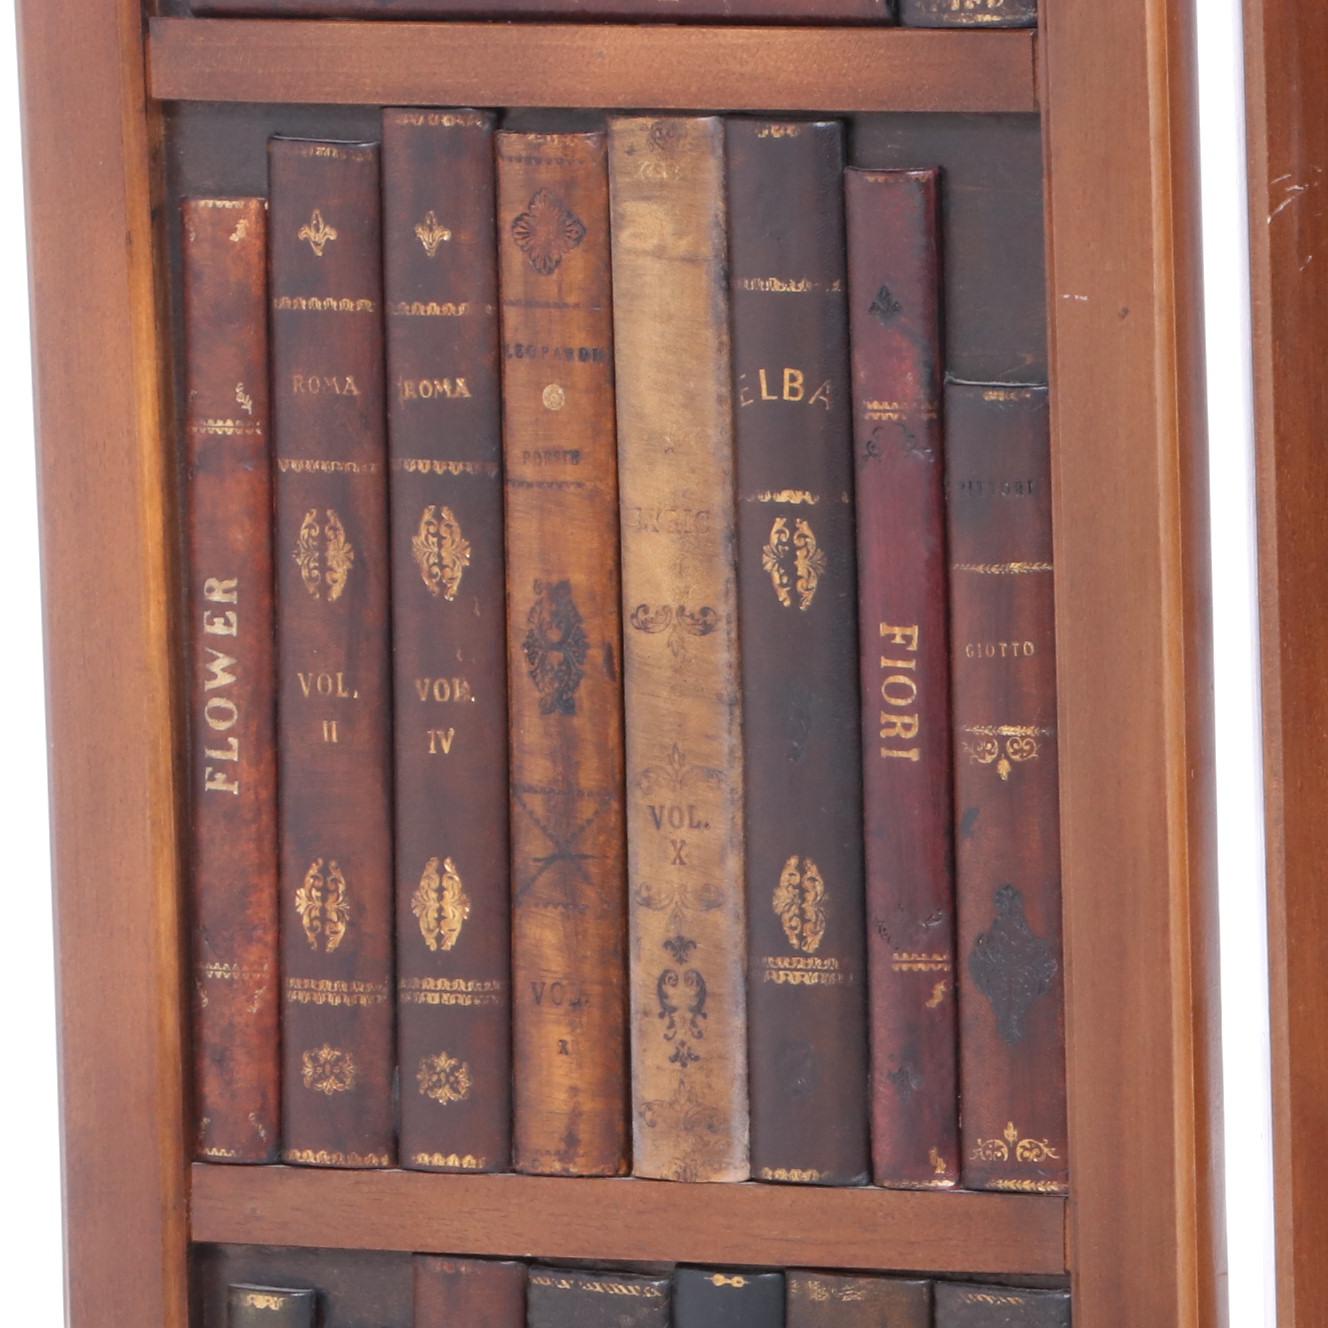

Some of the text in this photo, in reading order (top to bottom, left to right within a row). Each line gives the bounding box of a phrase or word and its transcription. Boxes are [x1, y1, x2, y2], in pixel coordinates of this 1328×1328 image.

[291, 376, 361, 396] ROMA
[401, 378, 472, 402] ROMA
[965, 641, 1036, 659] GIOTTO
[204, 576, 240, 796] FLOWER
[297, 671, 358, 699] VOL.
[879, 622, 920, 762] FIORI
[427, 727, 456, 755] IV
[648, 804, 712, 832] VOL.
[669, 838, 689, 866] X
